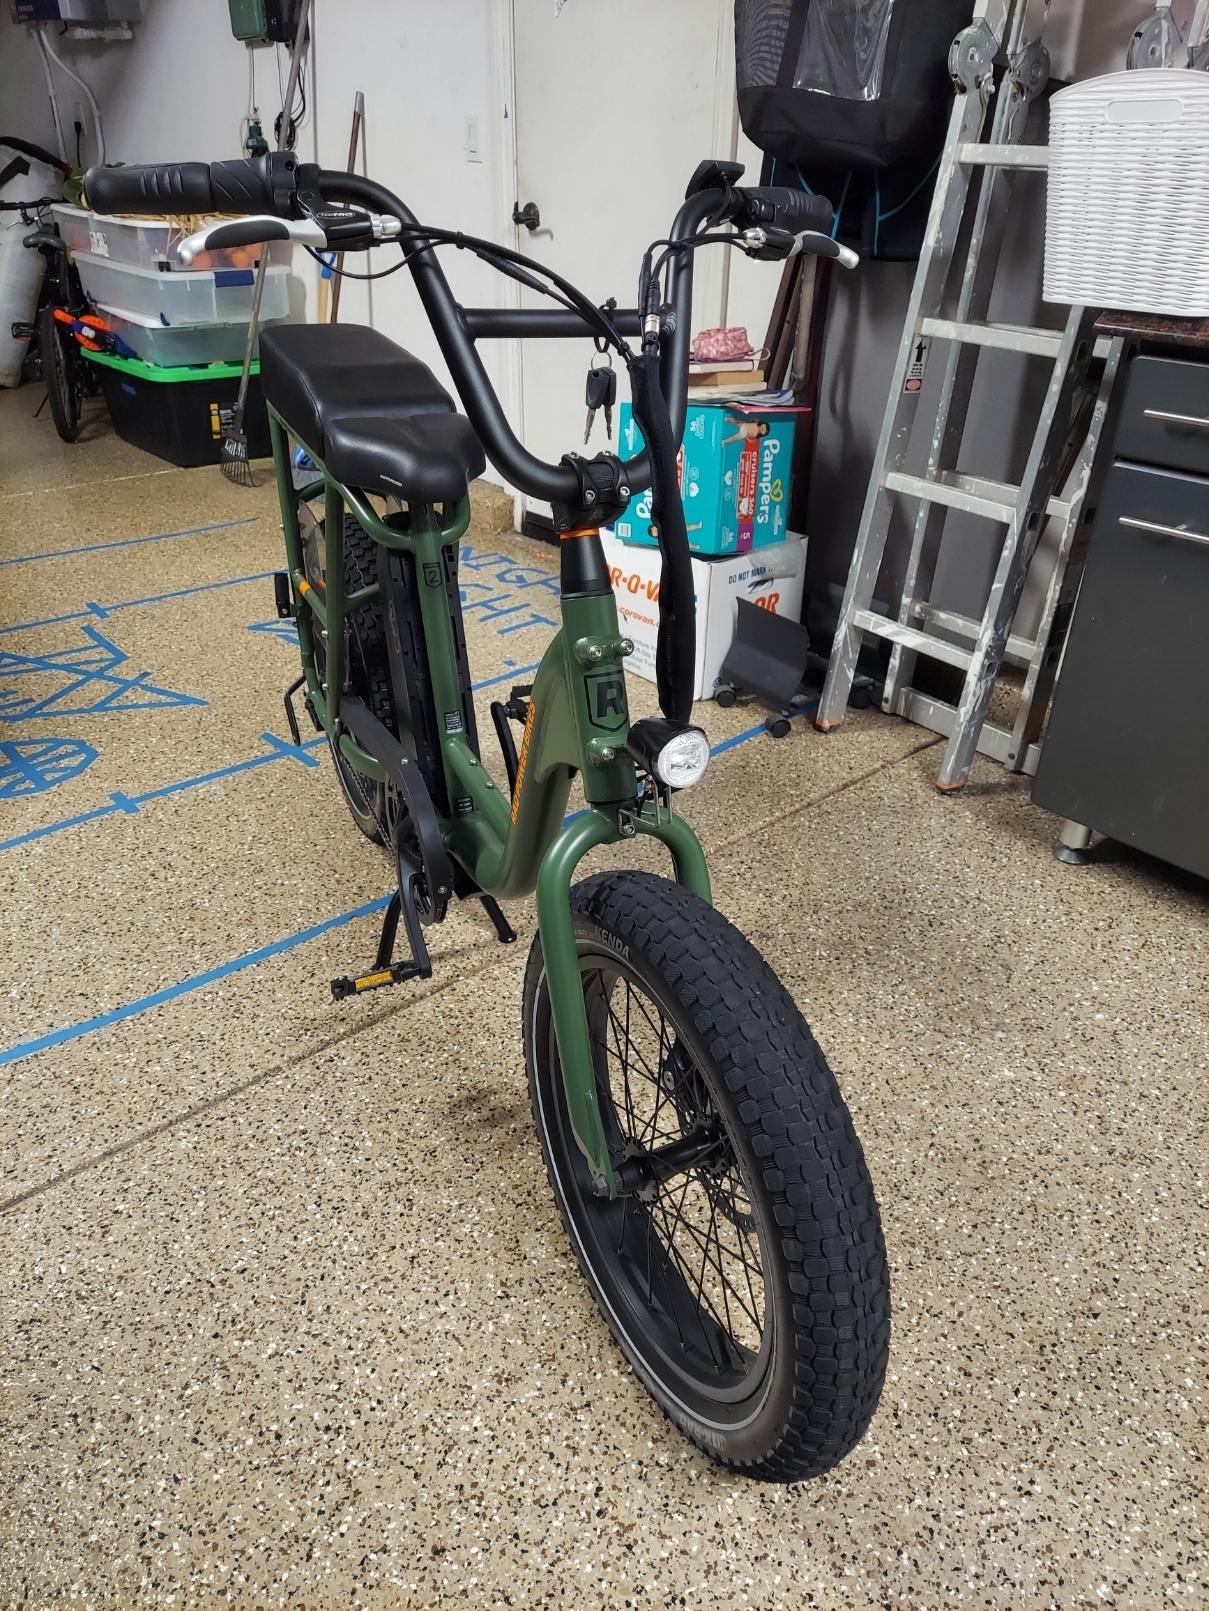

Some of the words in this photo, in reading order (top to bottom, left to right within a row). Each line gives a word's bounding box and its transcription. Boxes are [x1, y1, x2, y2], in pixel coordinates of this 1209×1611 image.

[750, 451, 758, 495] cruisers
[757, 439, 781, 524] Pampers
[743, 532, 751, 540] 5
[428, 569, 439, 583] 2
[728, 575, 737, 584] DO
[738, 570, 750, 582] NOT
[750, 566, 767, 577] MARK
[596, 680, 625, 718] R
[594, 925, 630, 960] KENDA
